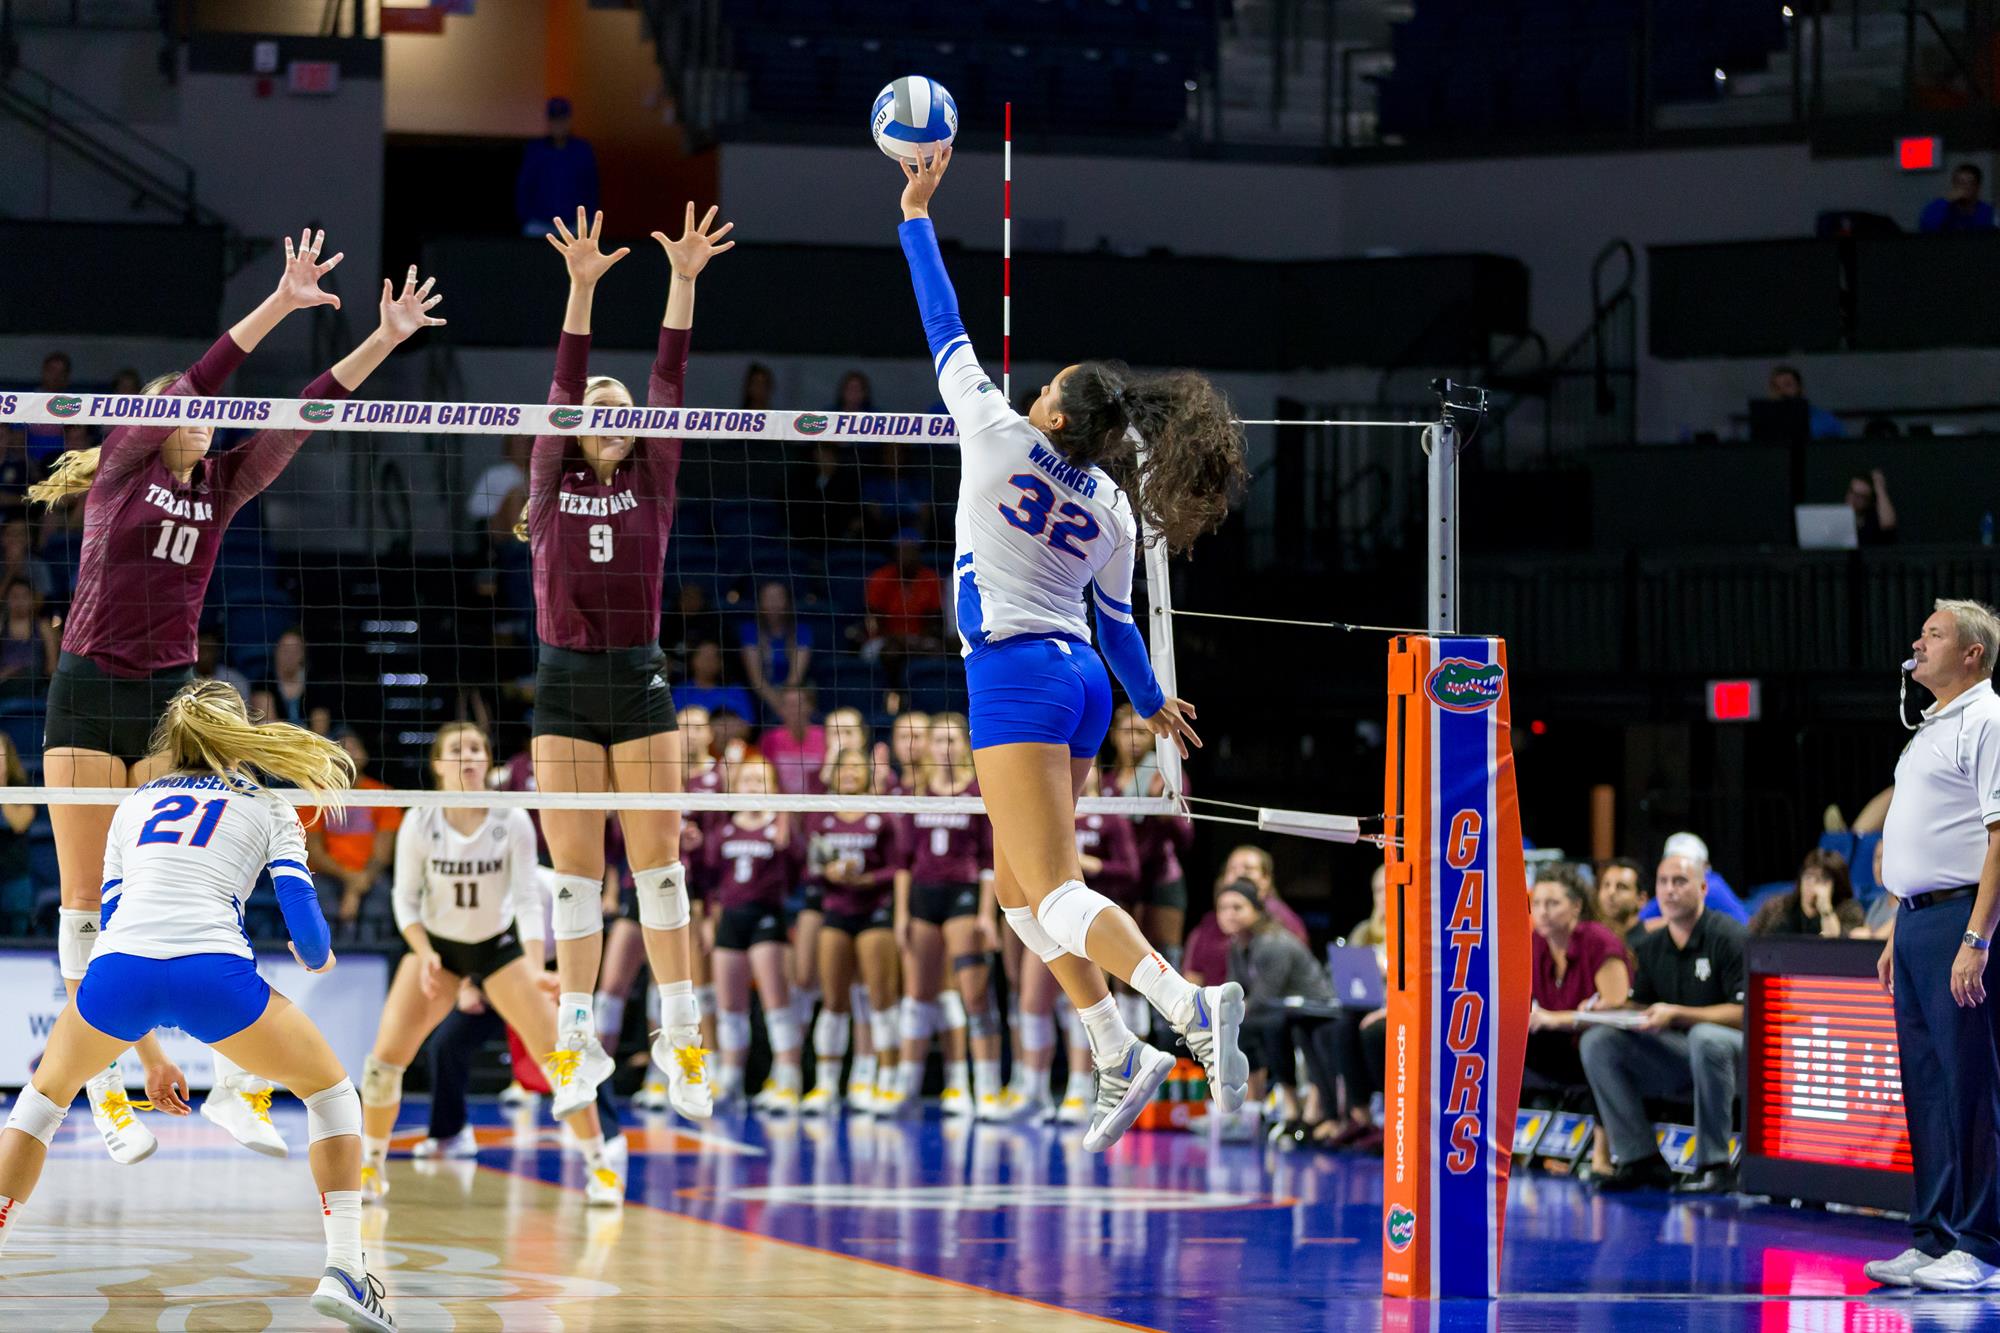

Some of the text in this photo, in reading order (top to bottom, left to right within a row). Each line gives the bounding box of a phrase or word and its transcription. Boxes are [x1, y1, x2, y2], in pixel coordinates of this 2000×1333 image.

[89, 397, 272, 421] FLORIDA GATORS
[341, 402, 521, 427] FLORIDA GATORS
[590, 408, 767, 433] FLORIDA GATORS
[835, 415, 960, 437] FLORIDA GA
[1027, 442, 1098, 499] WARNER
[145, 483, 191, 519] TEXAS
[559, 491, 608, 517] TEXAS
[998, 474, 1101, 561] 32
[152, 519, 200, 566] 10
[589, 524, 614, 563] 9
[136, 794, 230, 849] 21
[432, 859, 473, 875] TEXAS
[454, 882, 479, 908] 11
[1444, 808, 1486, 1175] GATORS
[1395, 1023, 1407, 1184] sports imports
